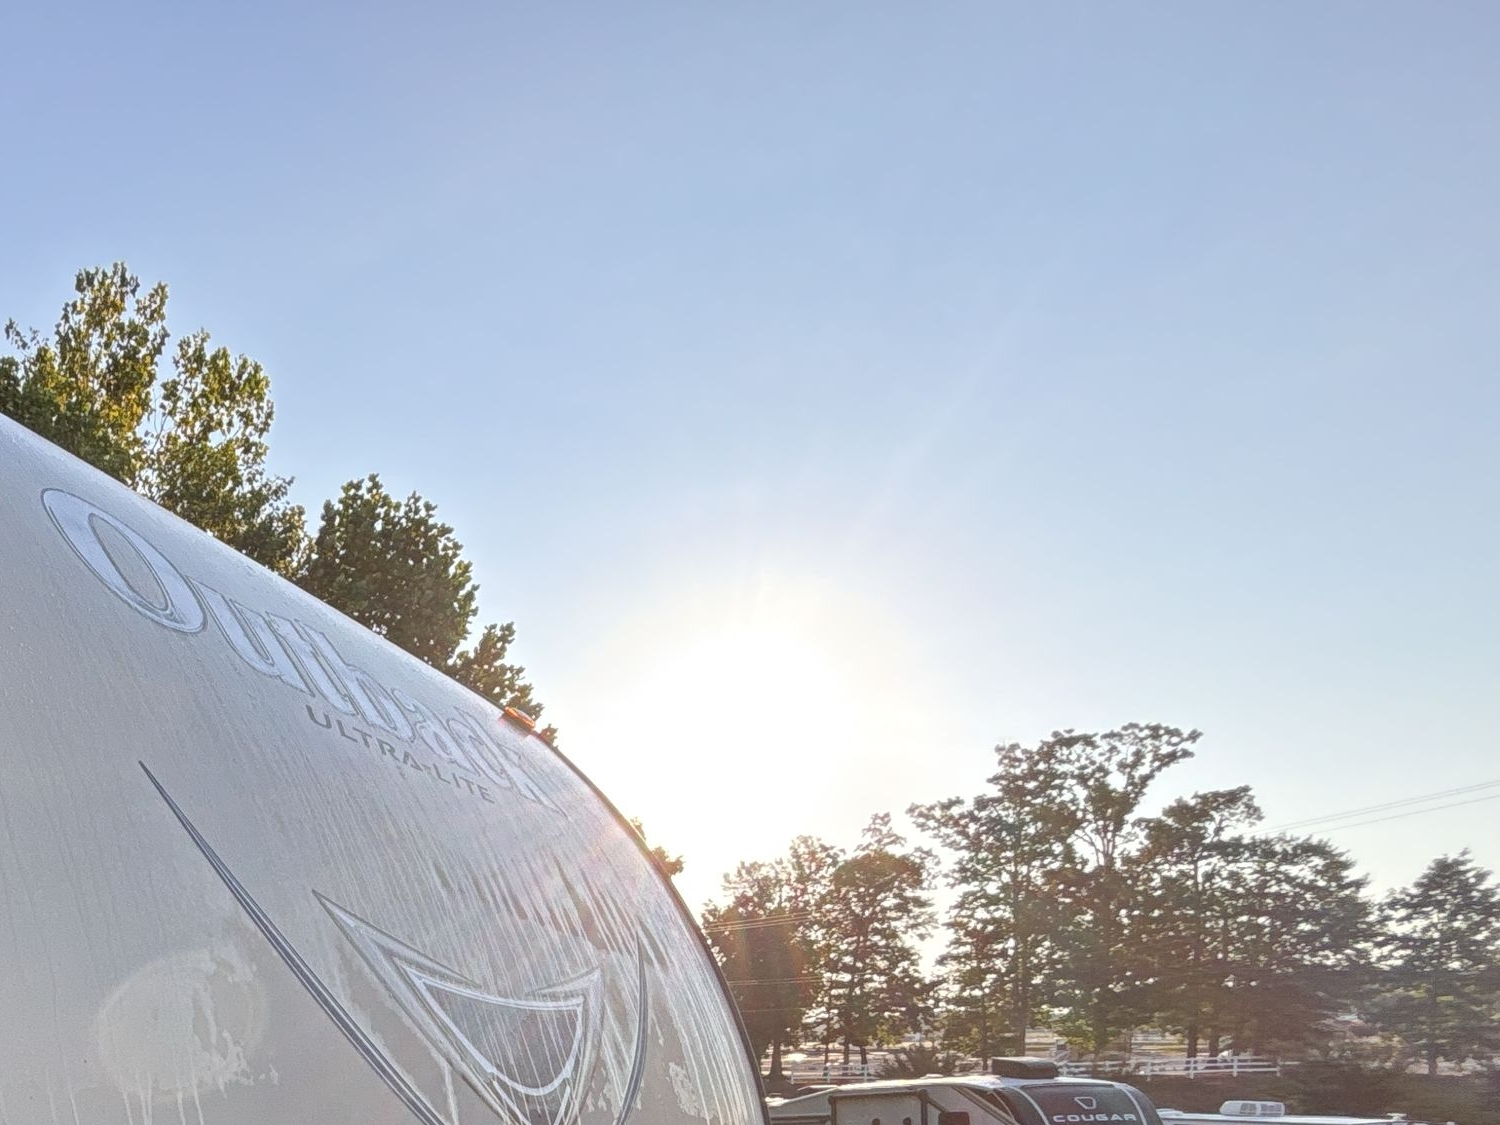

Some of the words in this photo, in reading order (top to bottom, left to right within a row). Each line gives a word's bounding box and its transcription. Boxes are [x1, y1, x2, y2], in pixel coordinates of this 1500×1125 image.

[40, 487, 568, 818] Outback
[305, 704, 495, 804] ULTRA-LITE
[1052, 1113, 1137, 1123] COUGAR
